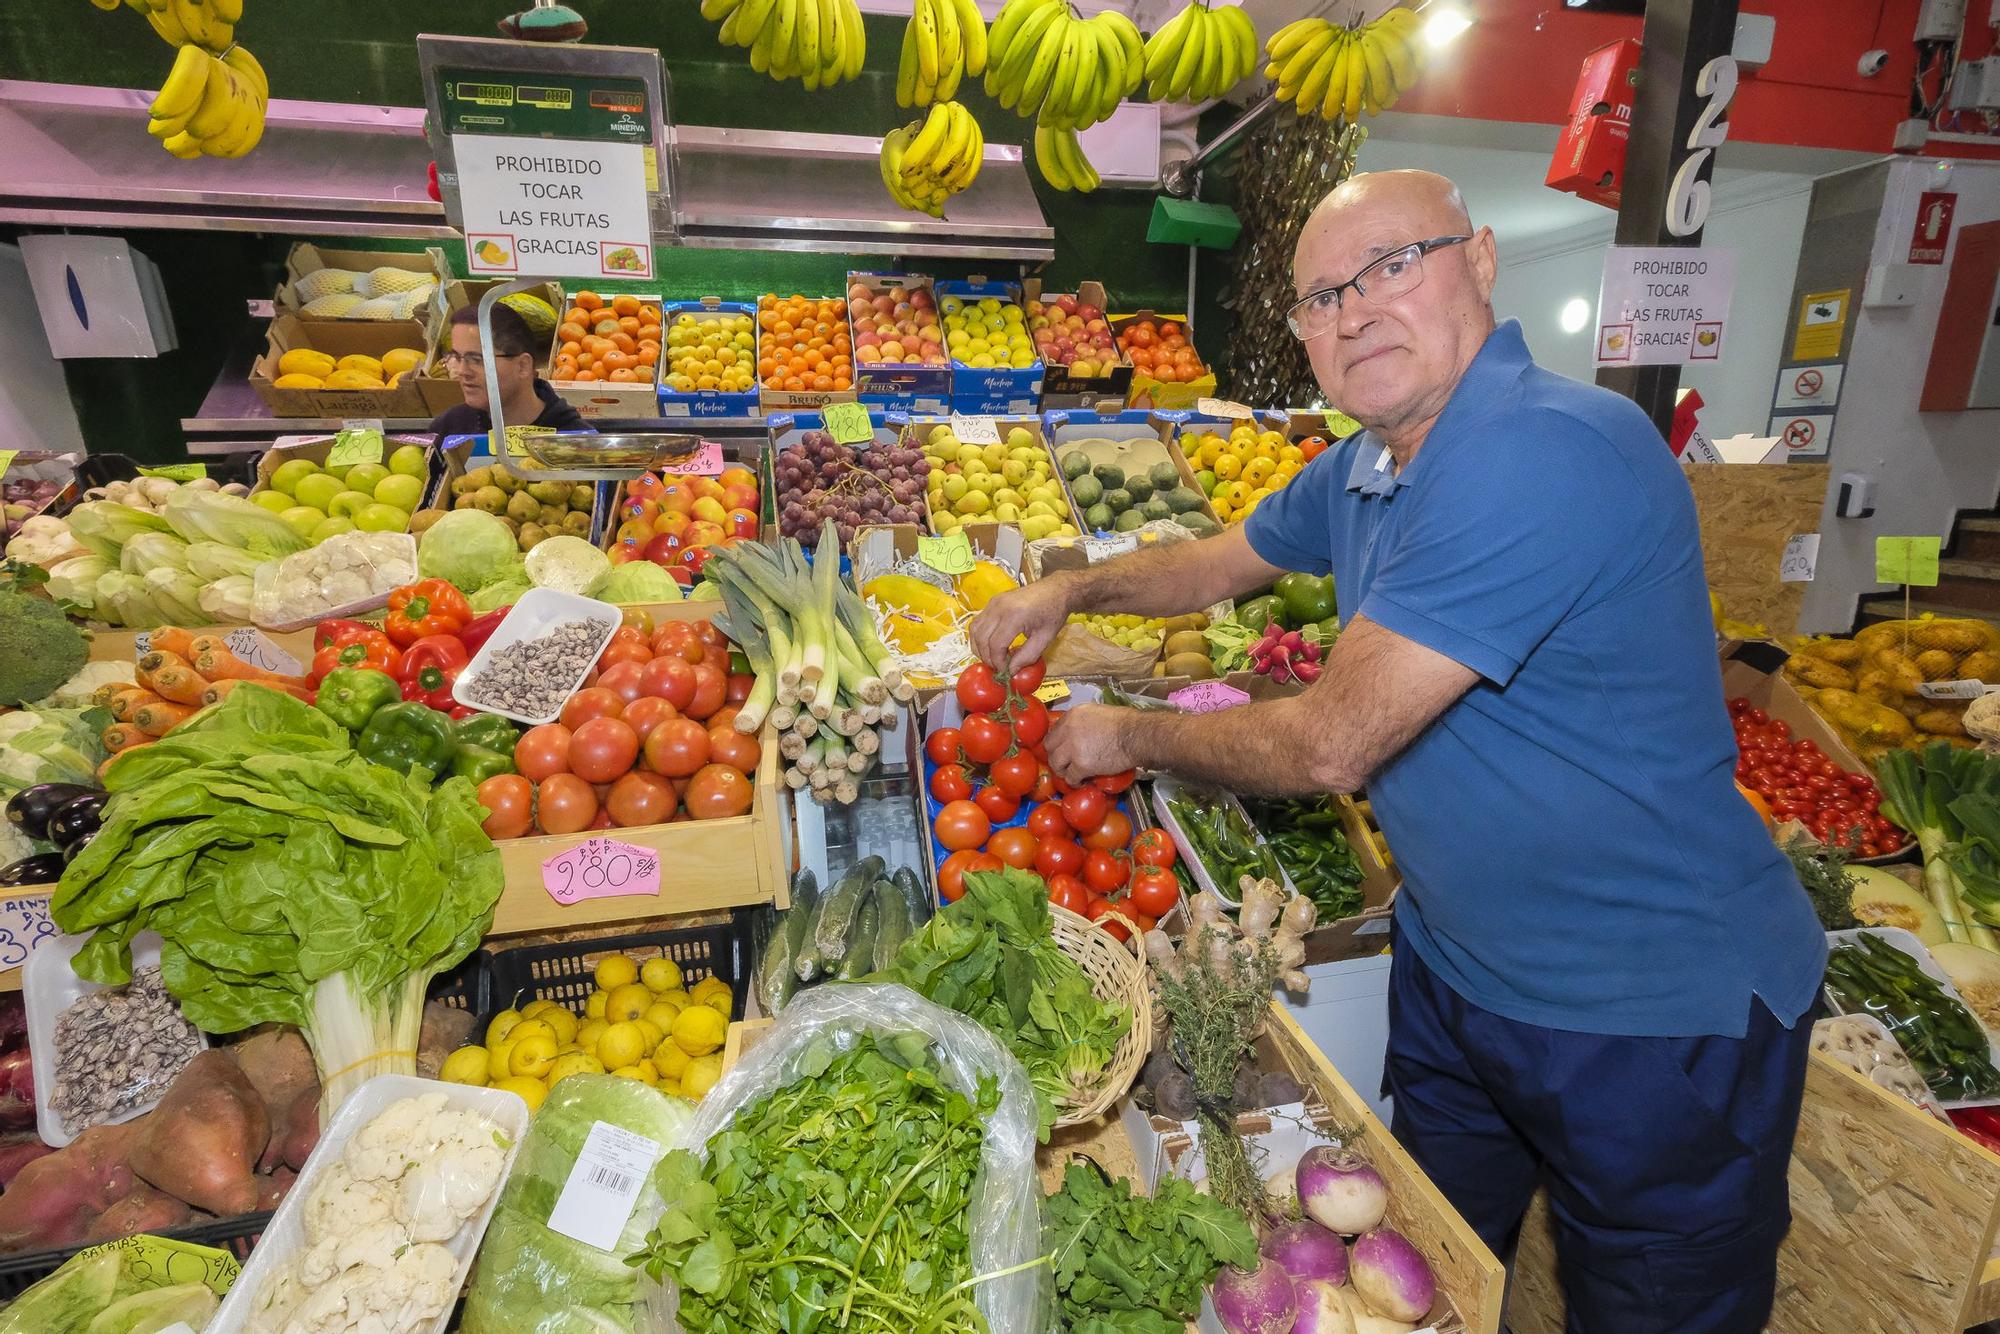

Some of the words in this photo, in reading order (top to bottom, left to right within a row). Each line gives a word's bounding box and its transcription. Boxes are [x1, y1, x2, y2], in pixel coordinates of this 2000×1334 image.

[610, 123, 646, 133] MINERVA
[1666, 55, 1739, 237] 26
[495, 155, 602, 175] PROHIBIDO
[520, 183, 584, 200] TOCAR
[499, 210, 533, 226] LAS
[540, 212, 610, 229] FRUTAS
[517, 238, 598, 256] GRACIAS
[1633, 261, 1708, 275] PROHIBIDO
[1647, 284, 1689, 298] TOCAR
[1626, 308, 1650, 322] LAS
[1654, 308, 1703, 322] FRUTAS
[1633, 332, 1690, 346] GRACIAS
